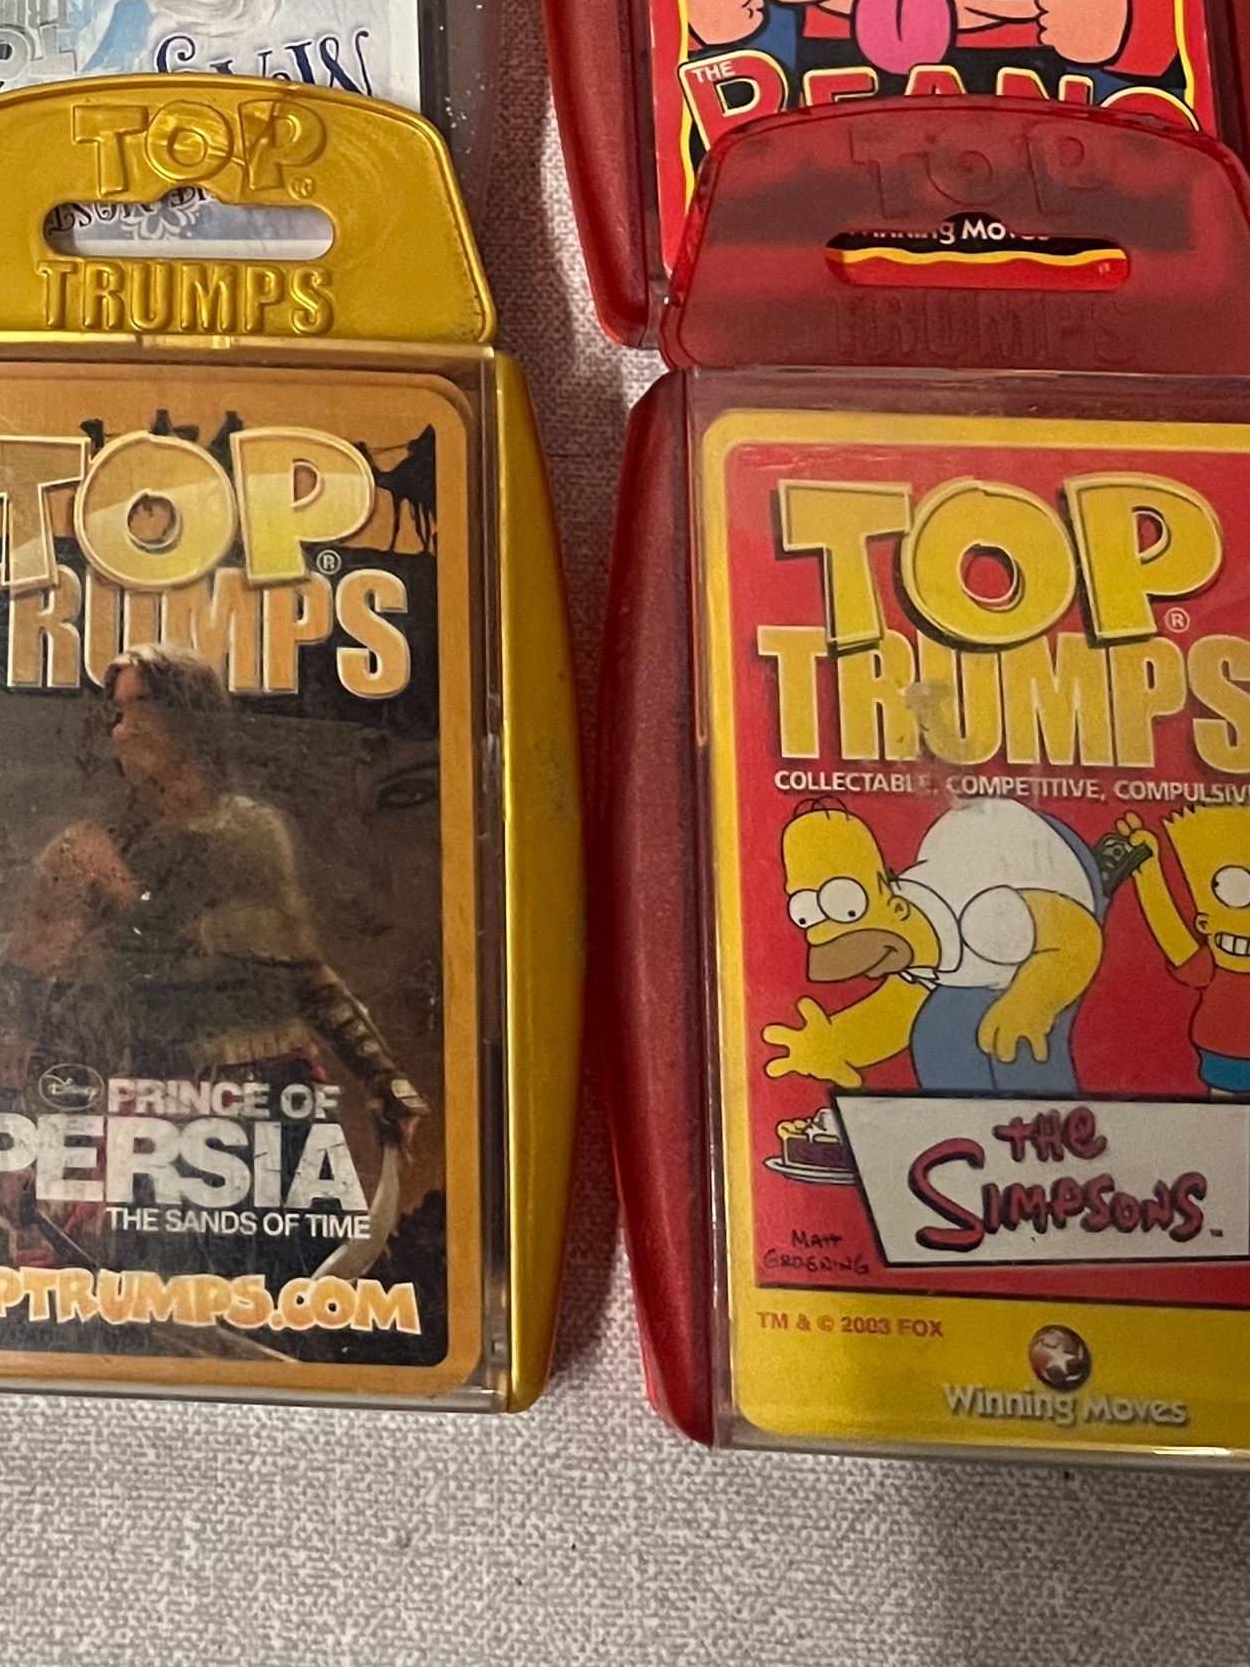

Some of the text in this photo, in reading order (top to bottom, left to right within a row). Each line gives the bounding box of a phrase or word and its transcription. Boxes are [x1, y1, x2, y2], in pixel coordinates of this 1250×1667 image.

[690, 60, 736, 83] THE
[70, 99, 327, 197] TOP
[37, 259, 335, 335] TRUMPS
[776, 471, 1224, 652] TOP
[756, 625, 1250, 775] TRUMPS
[946, 774, 1106, 800] COMPETITIVE,
[107, 1077, 342, 1120] PRINCE OF
[106, 1206, 372, 1240] THE SANDS OF TIME
[756, 1311, 789, 1330] TM
[795, 1314, 811, 1332] &
[840, 1315, 892, 1335] 2003
[897, 1318, 945, 1338] FOX
[942, 1382, 1078, 1426] Winning
